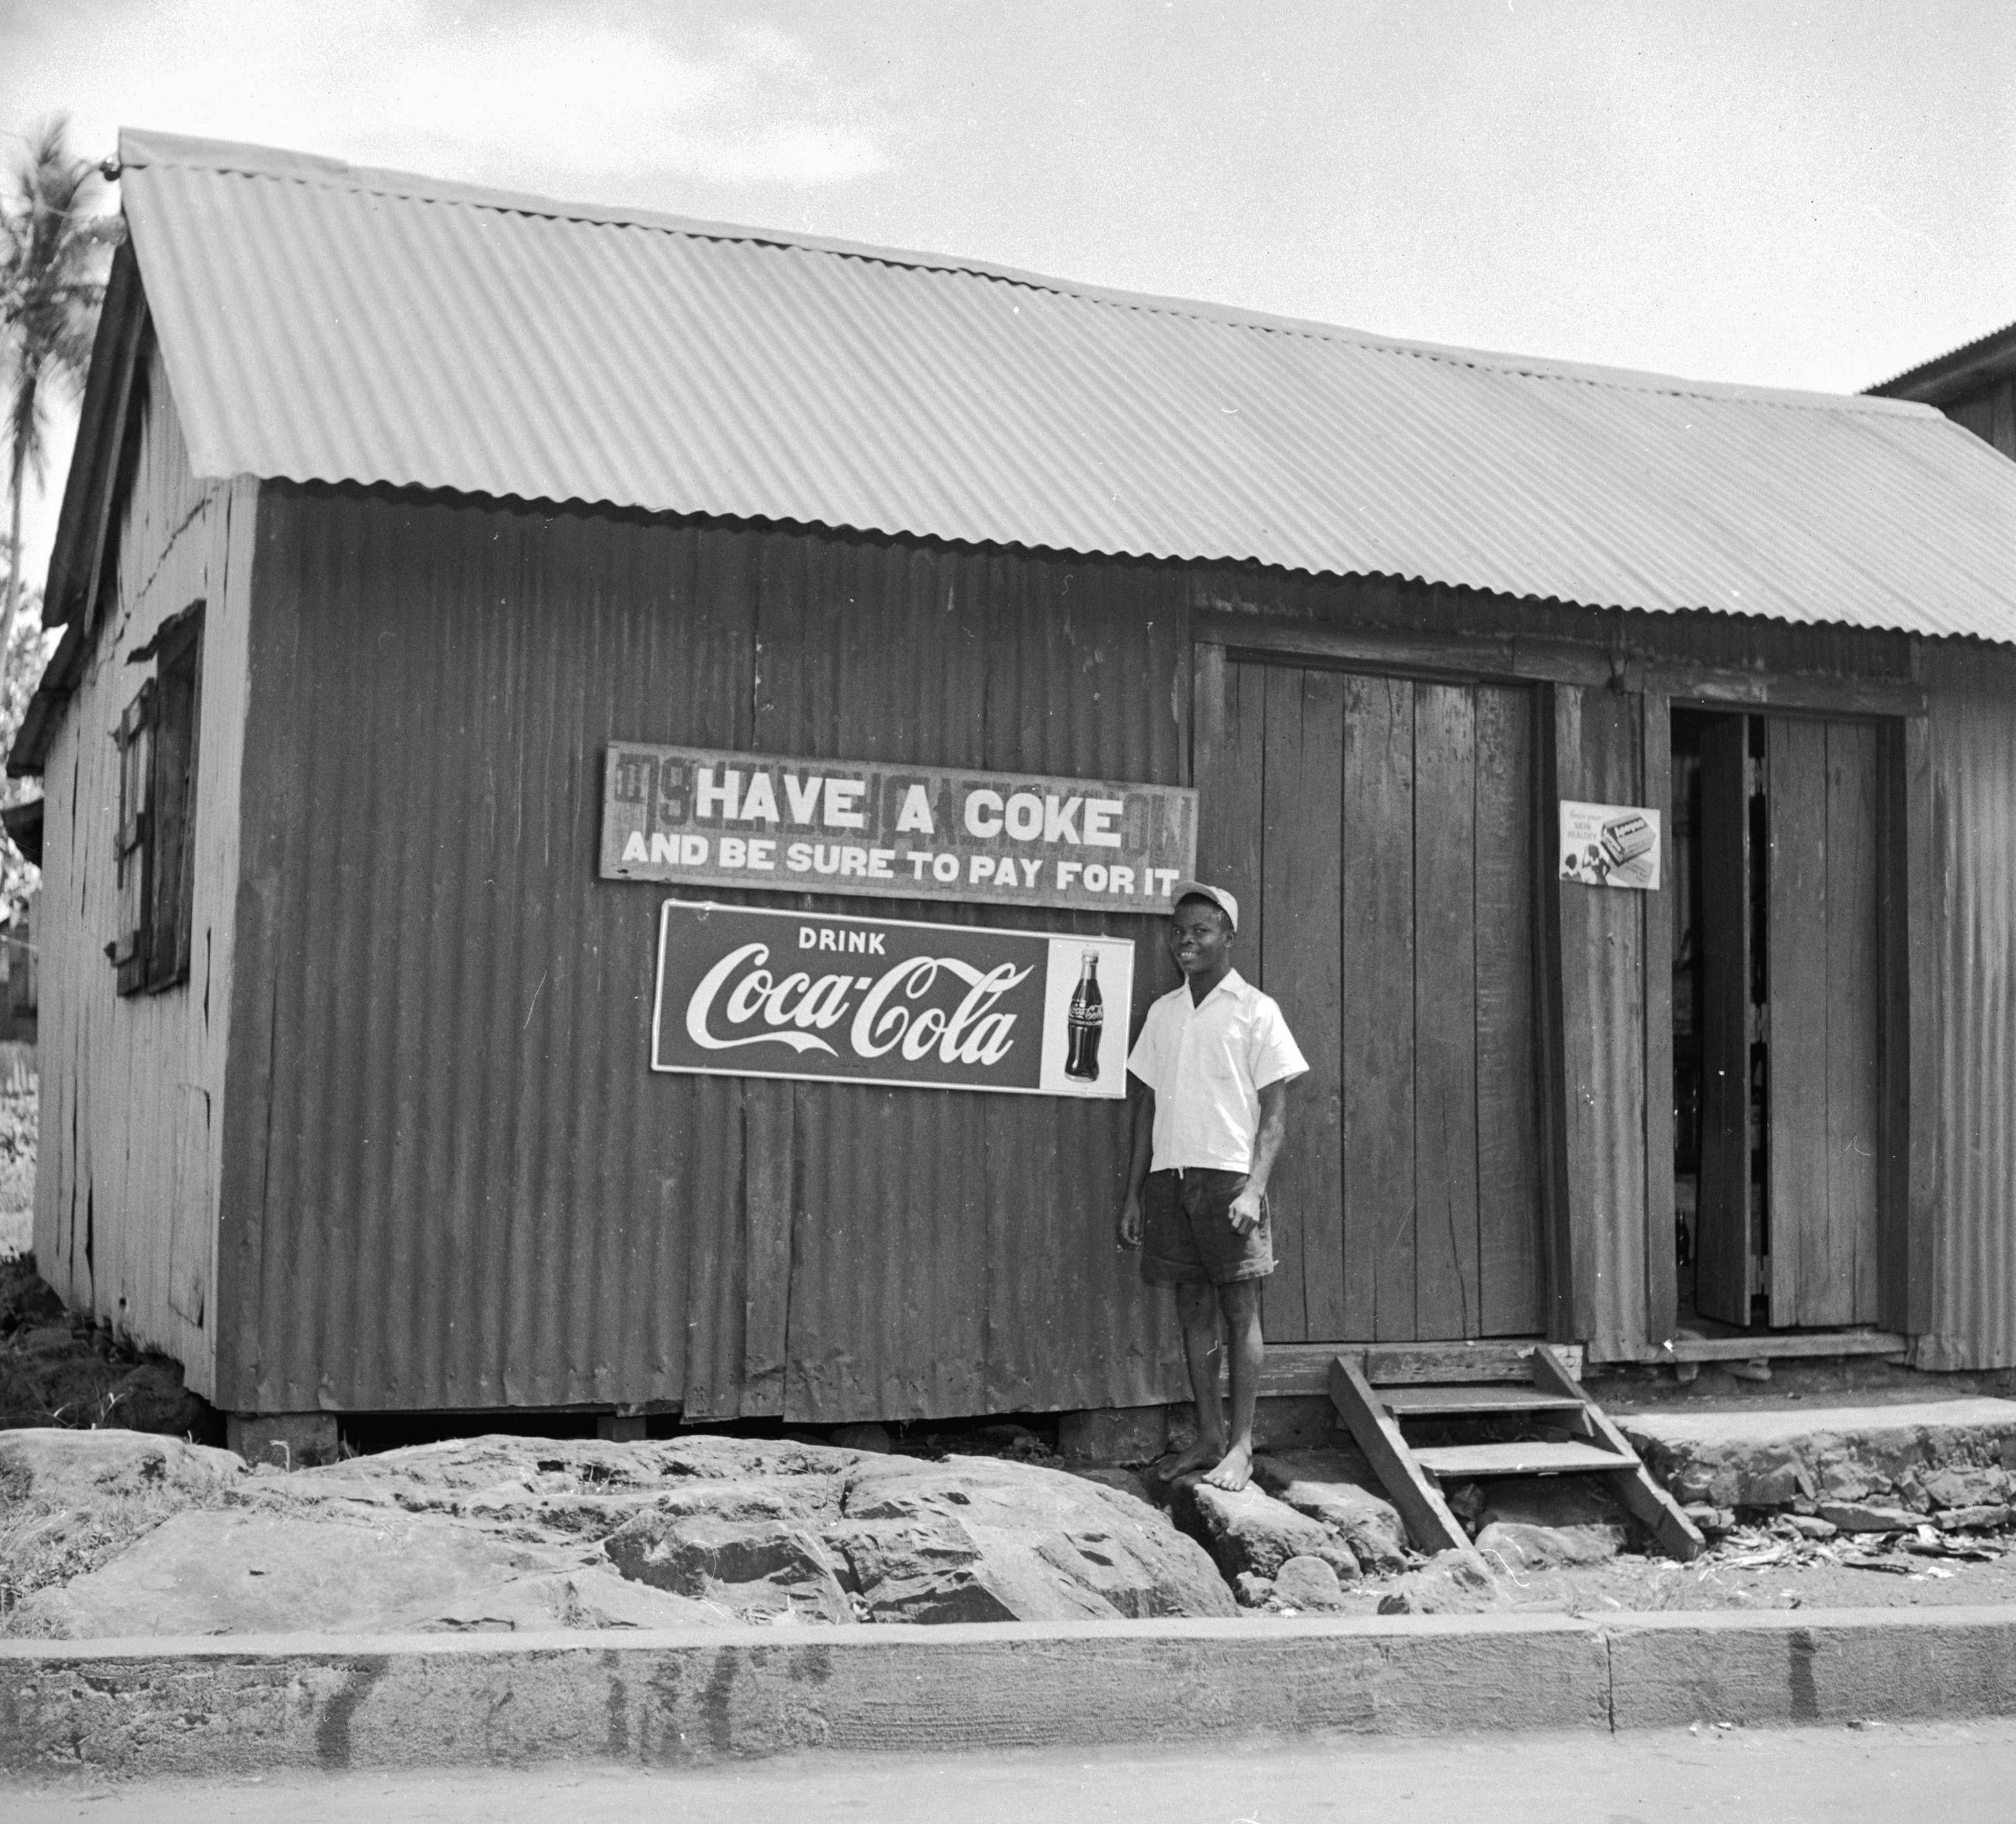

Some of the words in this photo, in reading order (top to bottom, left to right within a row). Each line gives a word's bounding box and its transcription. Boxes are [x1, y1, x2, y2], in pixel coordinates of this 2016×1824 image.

[697, 768, 866, 829] HAVE
[896, 784, 935, 834] A
[964, 789, 1124, 848] COKE
[621, 831, 709, 867] AND
[718, 837, 777, 870] BE
[786, 842, 896, 879] SURE
[907, 851, 960, 882] TO
[969, 855, 1044, 888] PAY
[1056, 861, 1135, 895] FOR
[1143, 867, 1180, 897] IT
[798, 926, 886, 955] DRINK
[686, 942, 1035, 1066] Coca-Cola
